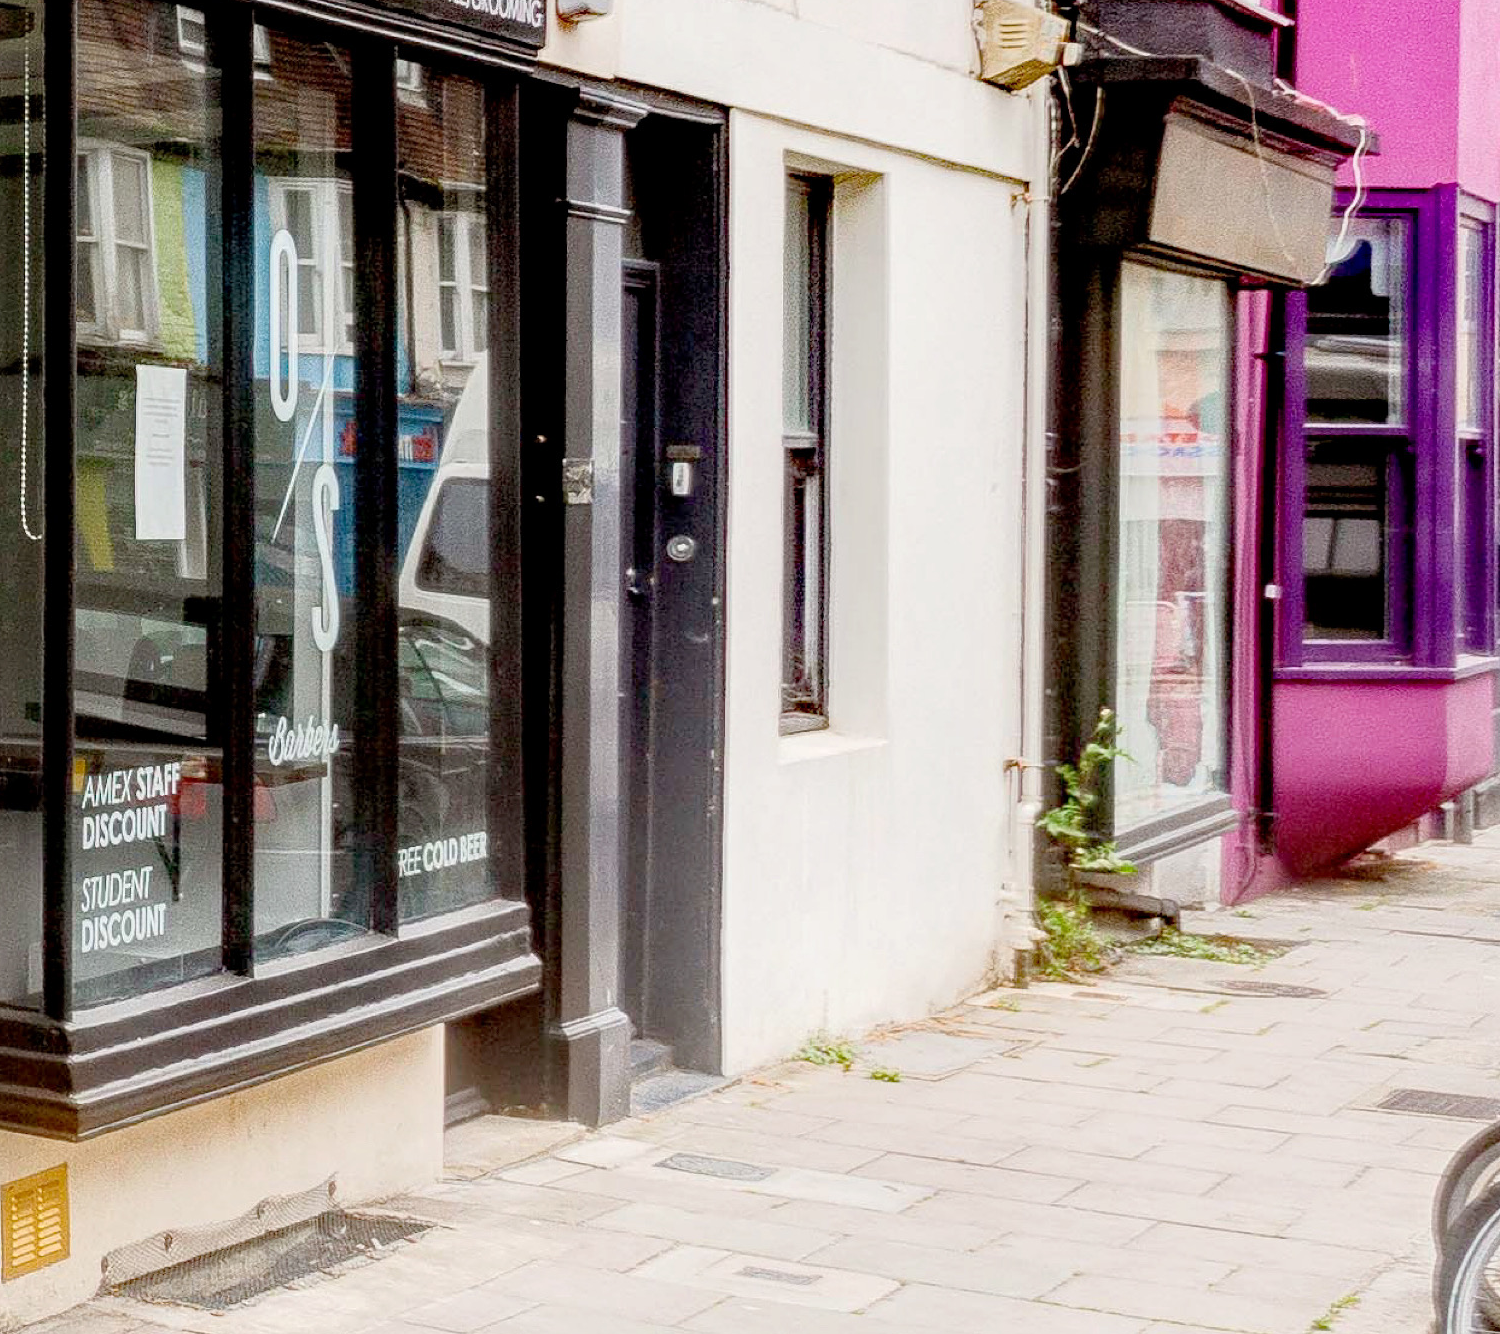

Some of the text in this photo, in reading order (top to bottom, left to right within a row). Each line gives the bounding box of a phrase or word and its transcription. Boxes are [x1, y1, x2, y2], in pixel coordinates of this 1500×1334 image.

[268, 714, 340, 767] Barbers
[81, 762, 181, 809] AMEX STAFF
[82, 804, 168, 850] DISCOUNT
[422, 837, 458, 872] COLD
[459, 831, 487, 864] BEER
[81, 866, 153, 913] STUDENT
[81, 903, 167, 953] DISCOUNT
